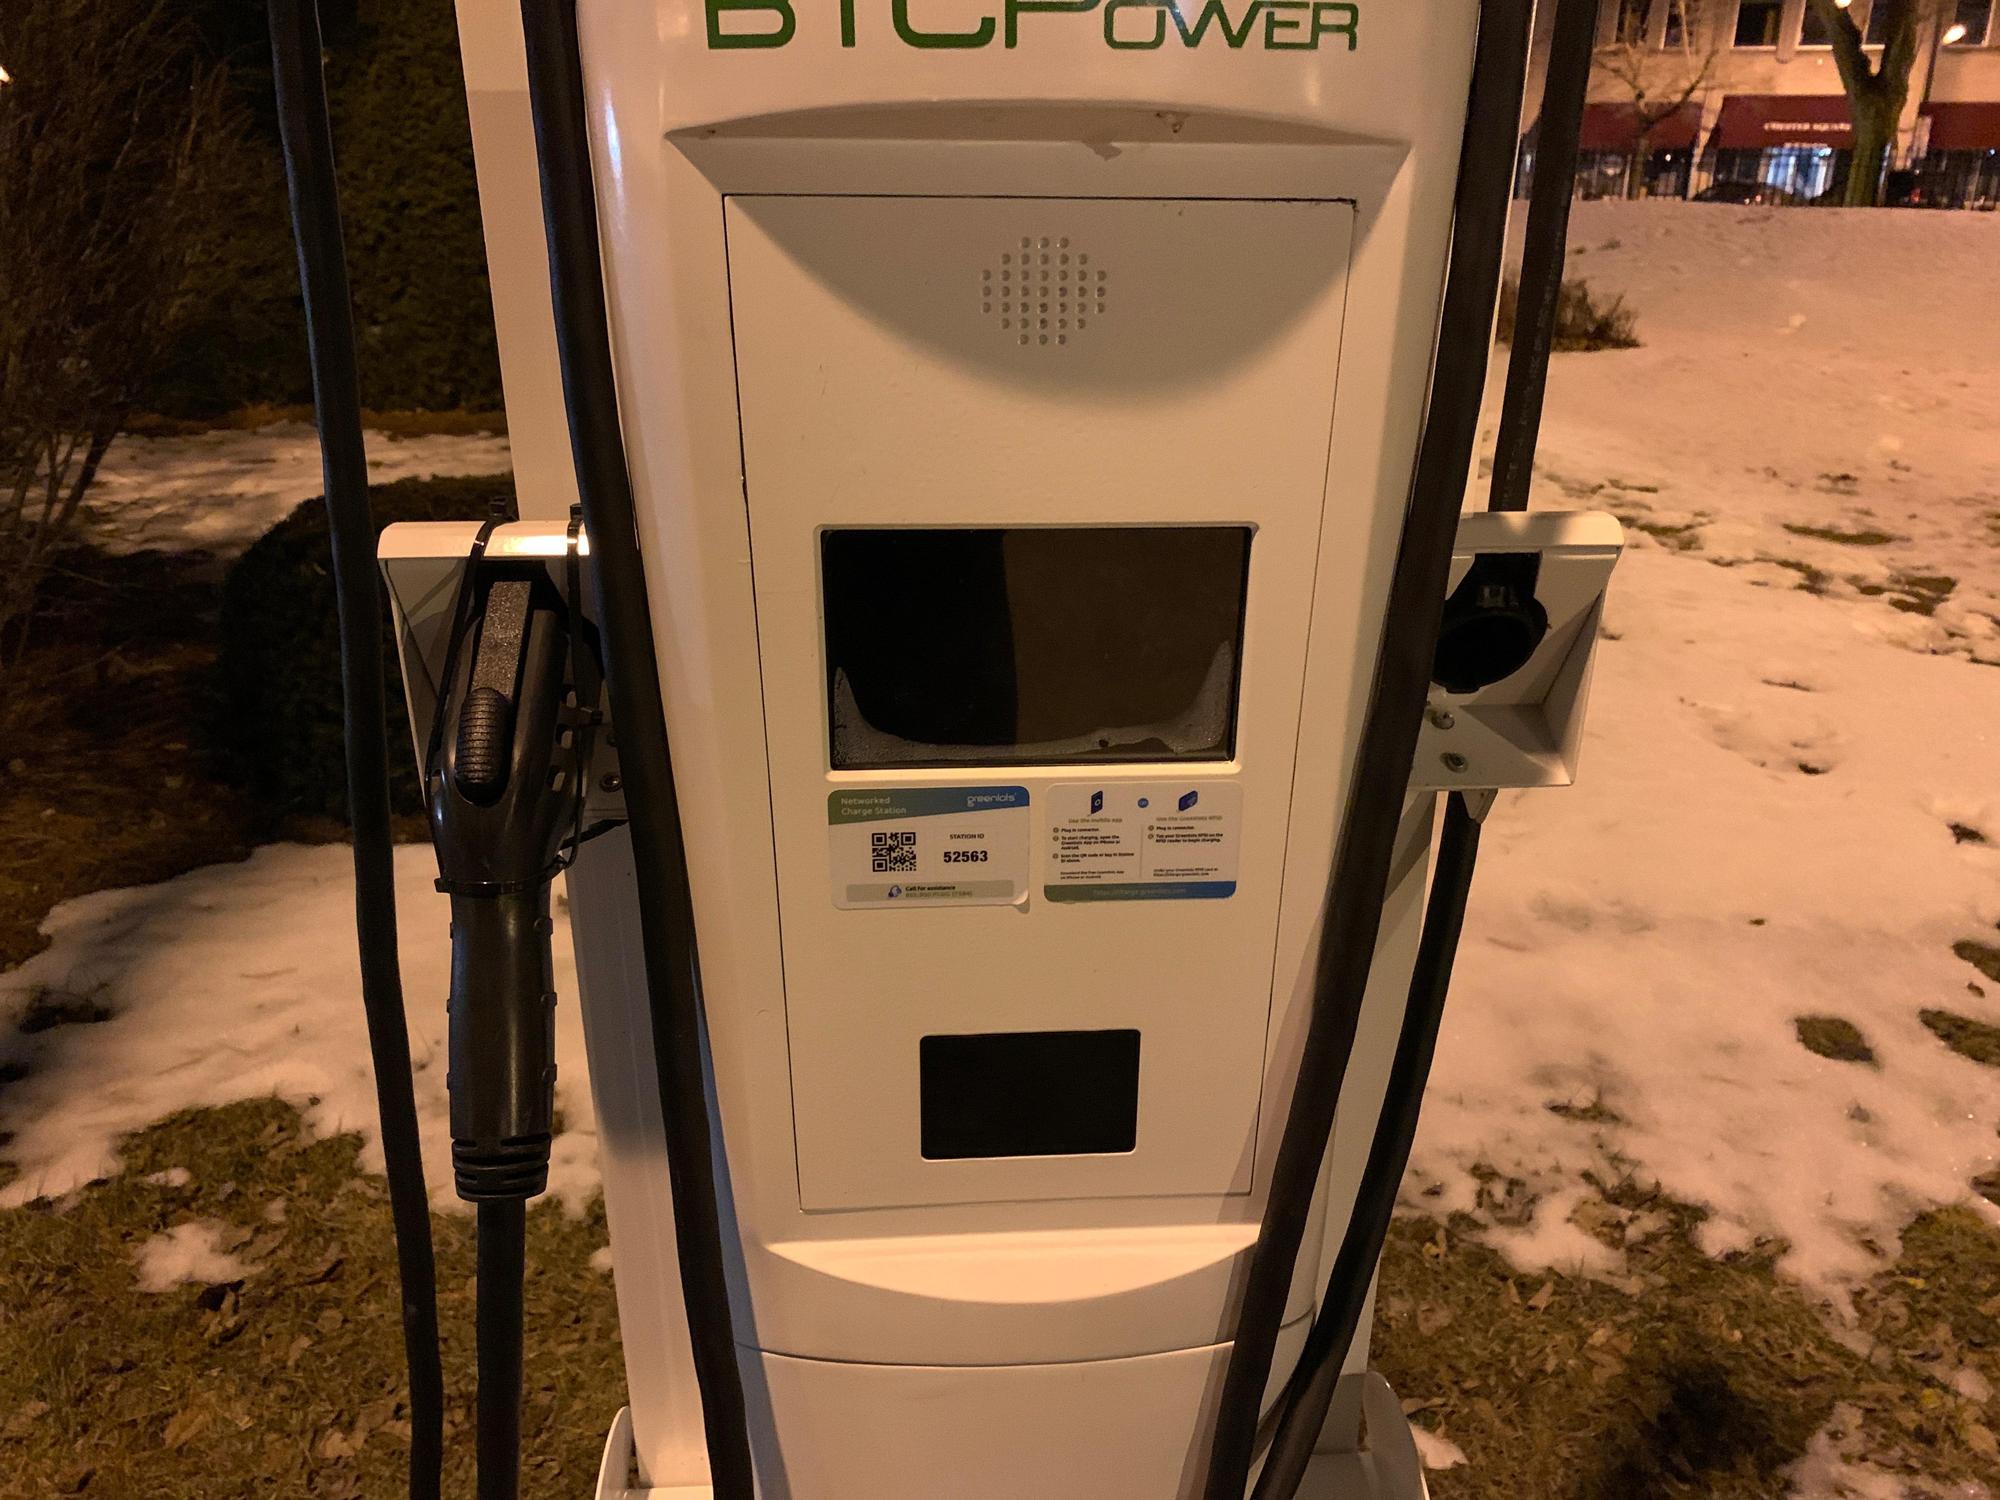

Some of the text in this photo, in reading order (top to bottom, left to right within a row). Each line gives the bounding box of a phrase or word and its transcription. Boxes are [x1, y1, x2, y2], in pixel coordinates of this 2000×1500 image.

[841, 797, 890, 805] Networked
[967, 793, 1014, 807] greenlots
[841, 807, 906, 816] Charge Station
[944, 850, 988, 863] 52563
